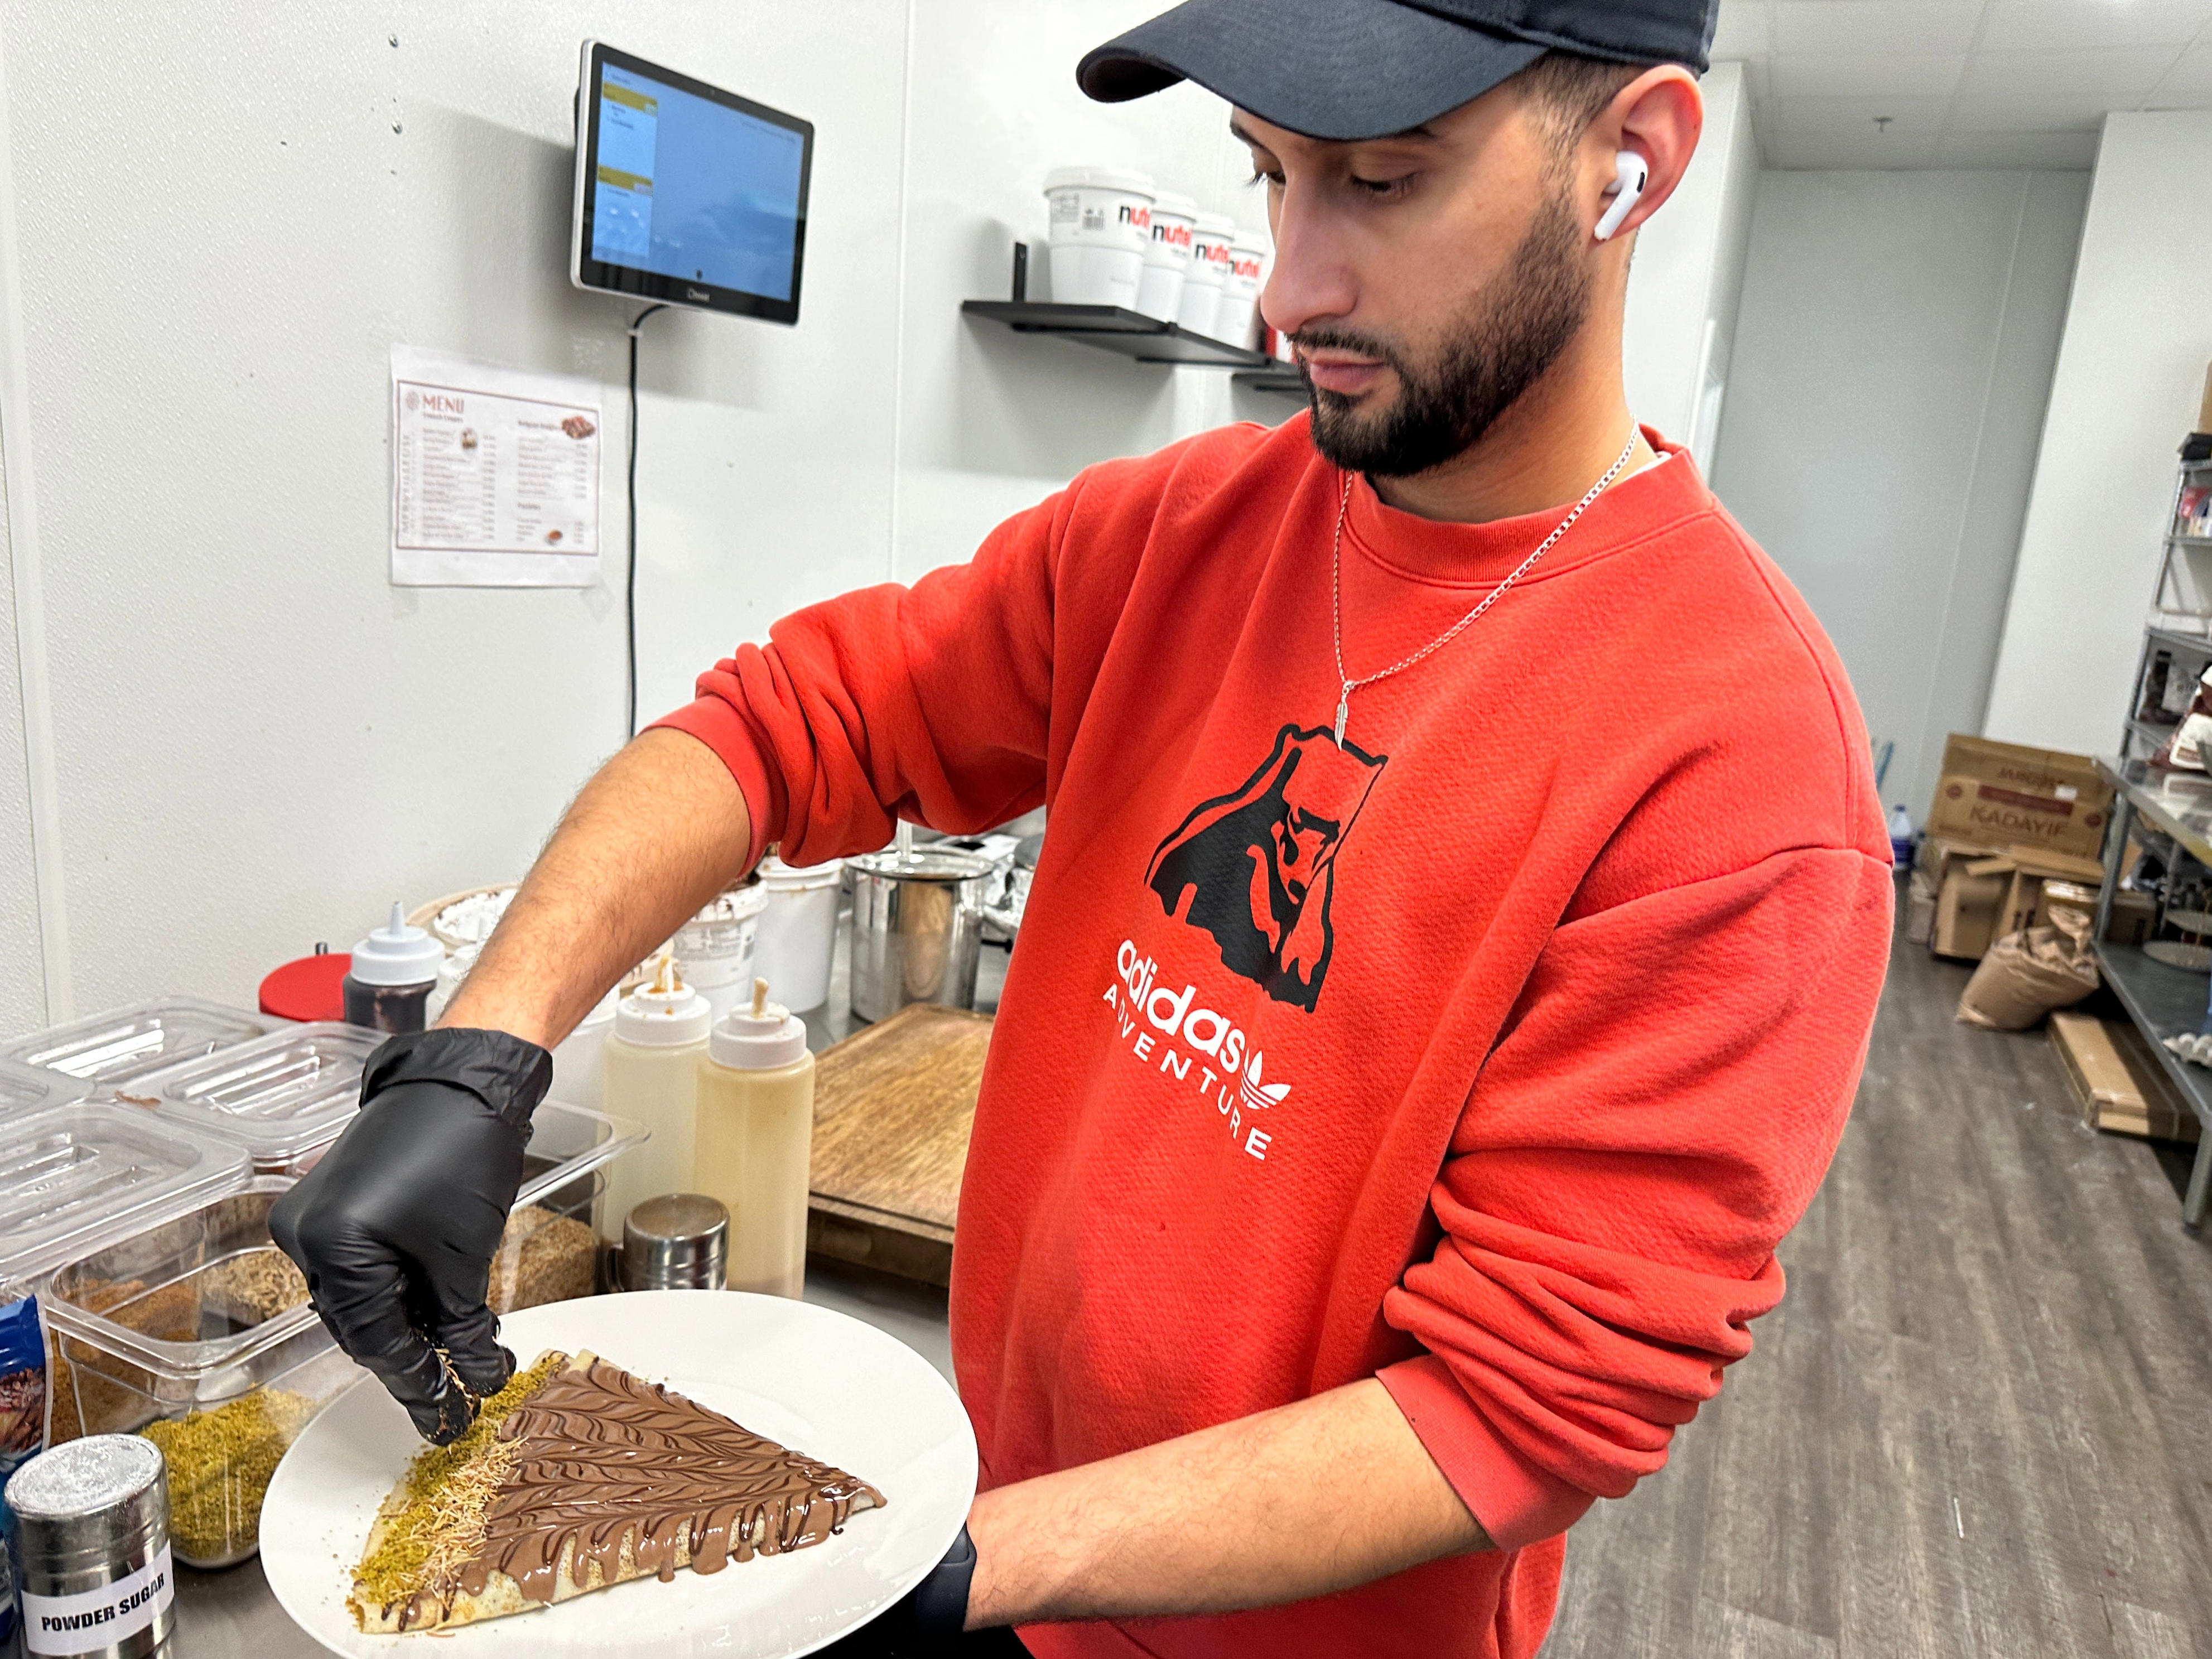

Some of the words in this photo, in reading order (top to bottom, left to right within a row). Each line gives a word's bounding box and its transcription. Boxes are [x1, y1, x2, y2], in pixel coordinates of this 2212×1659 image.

[423, 393, 464, 413] MENU
[1117, 939, 1246, 1073] adidas
[1102, 982, 1273, 1160] ADVENTURE
[41, 1605, 115, 1631] POWDER
[119, 1572, 165, 1614] SUGAR
